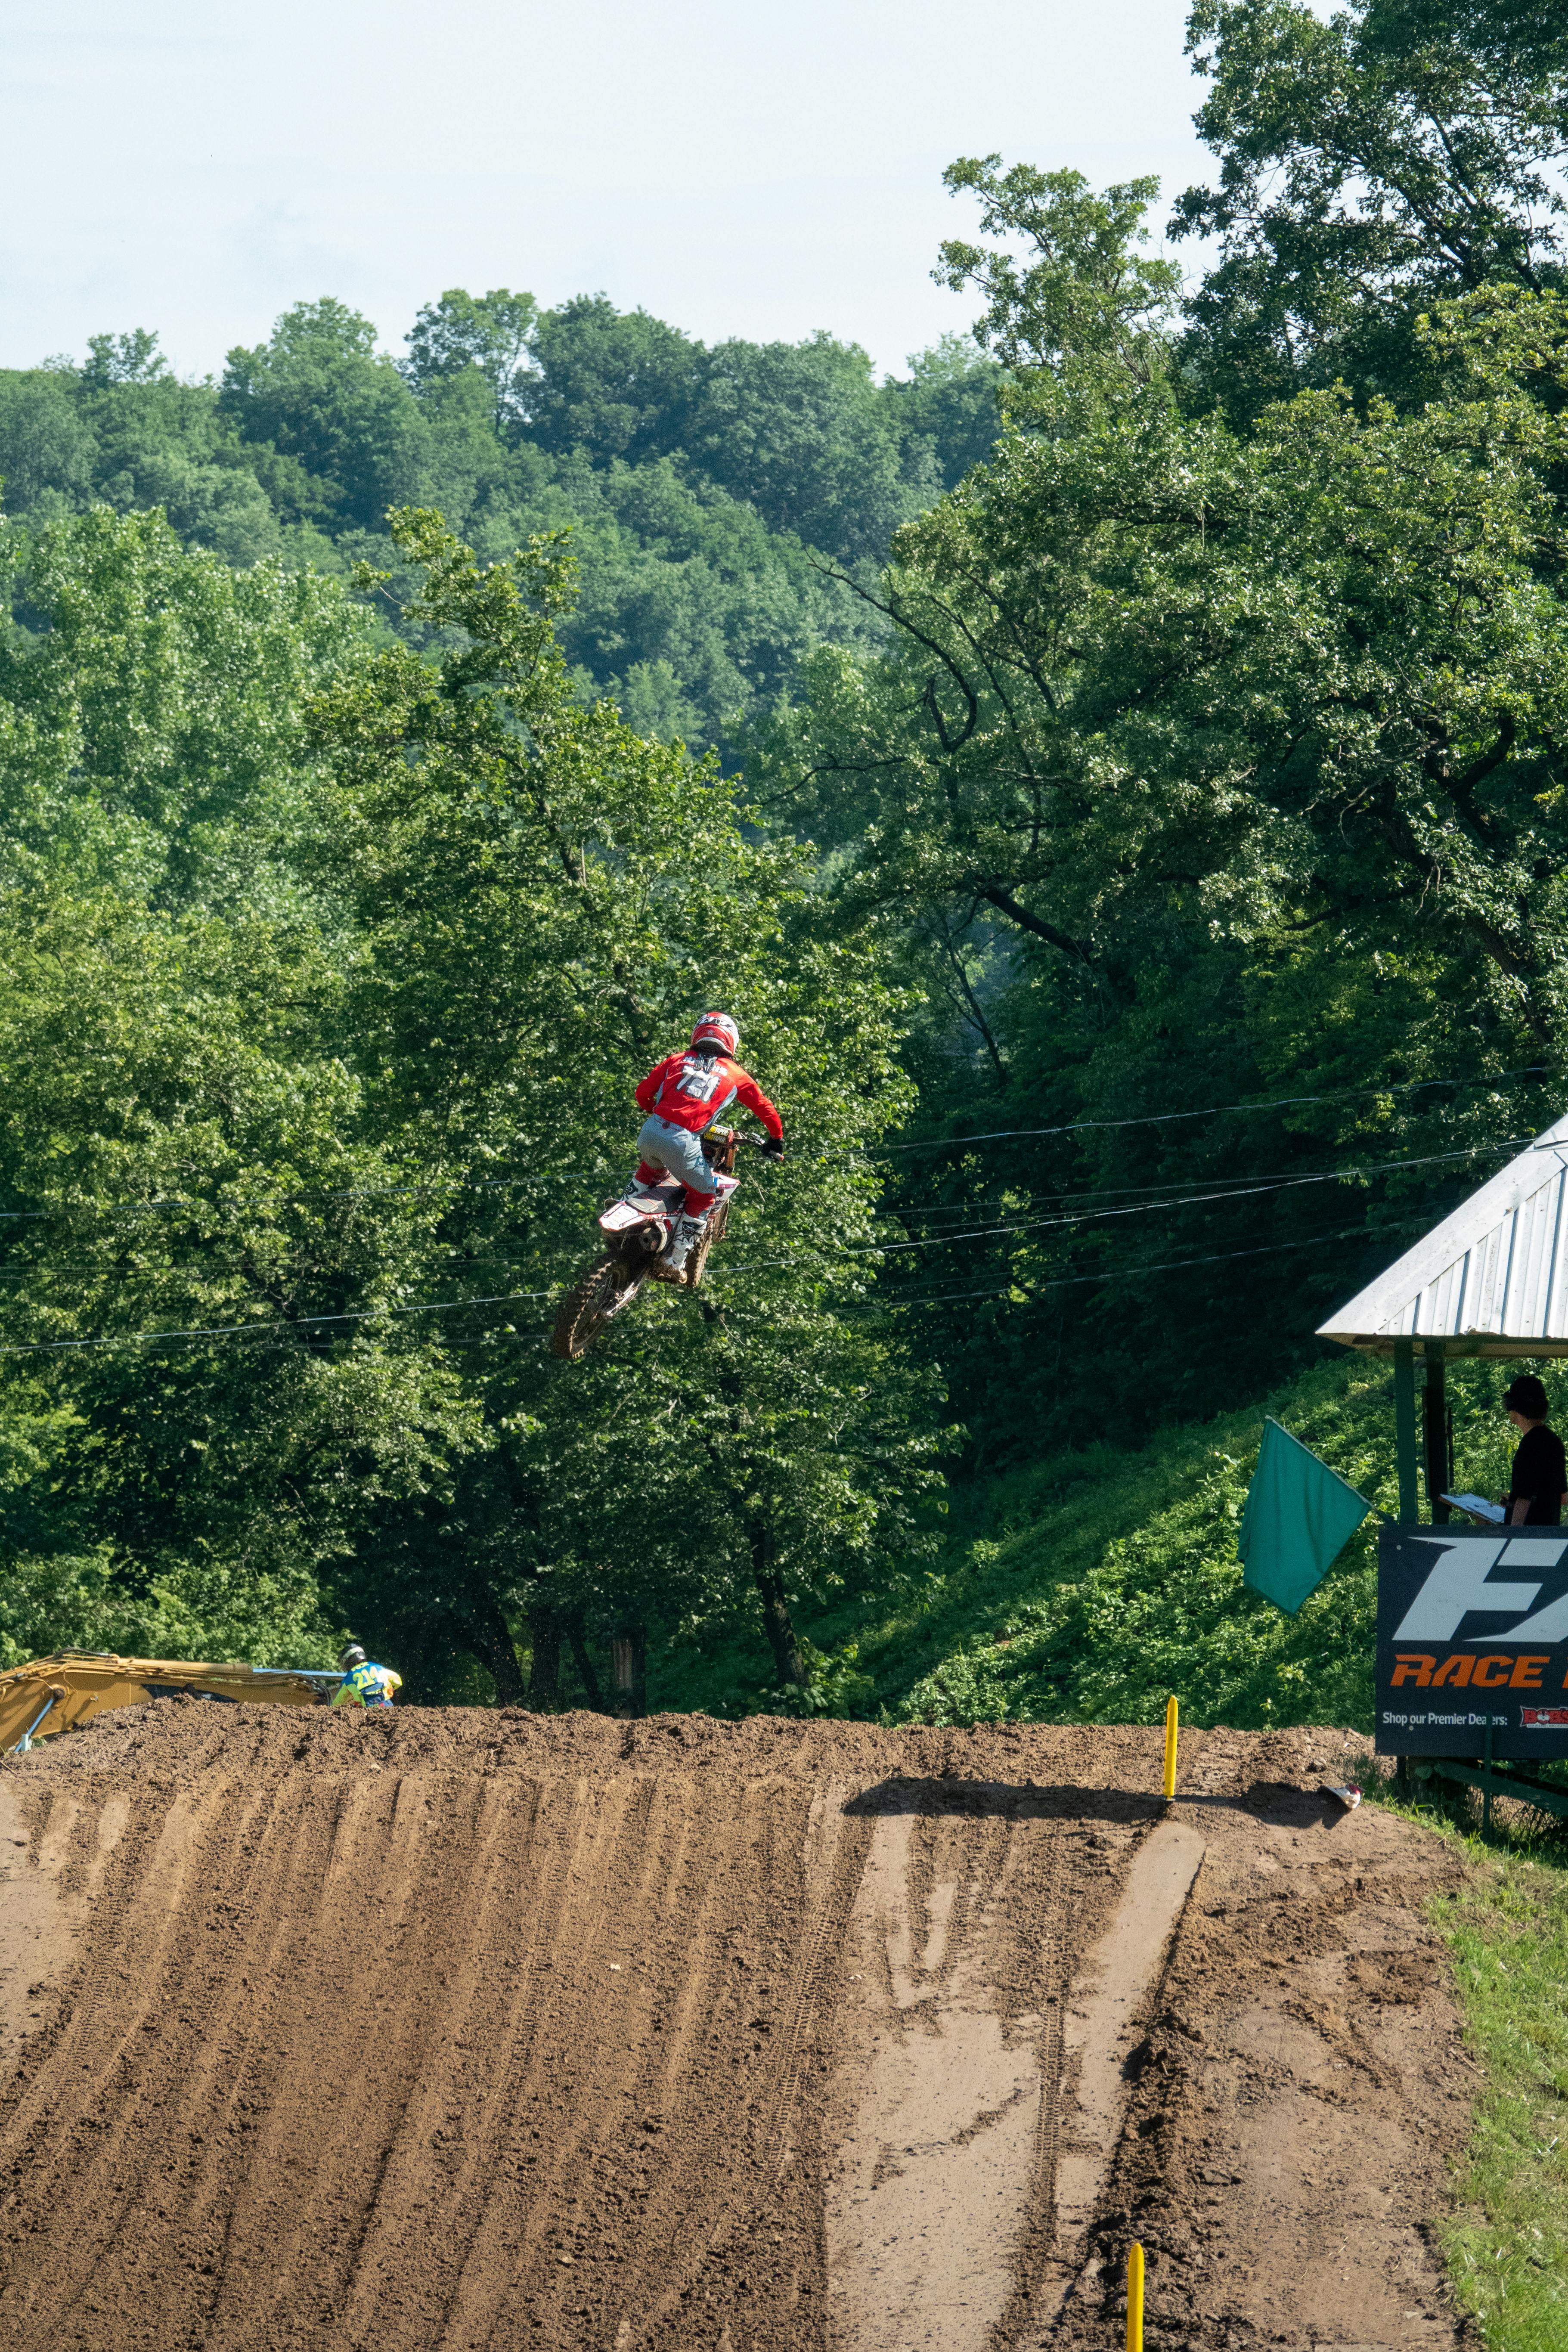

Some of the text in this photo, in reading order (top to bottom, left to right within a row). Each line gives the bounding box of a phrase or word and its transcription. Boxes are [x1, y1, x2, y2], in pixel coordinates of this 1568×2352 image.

[676, 1065, 720, 1102] 721
[353, 1666, 382, 1690] 214
[1390, 1655, 1550, 1687] RACE
[1382, 1712, 1508, 1726] Shop our Premier Deaers:
